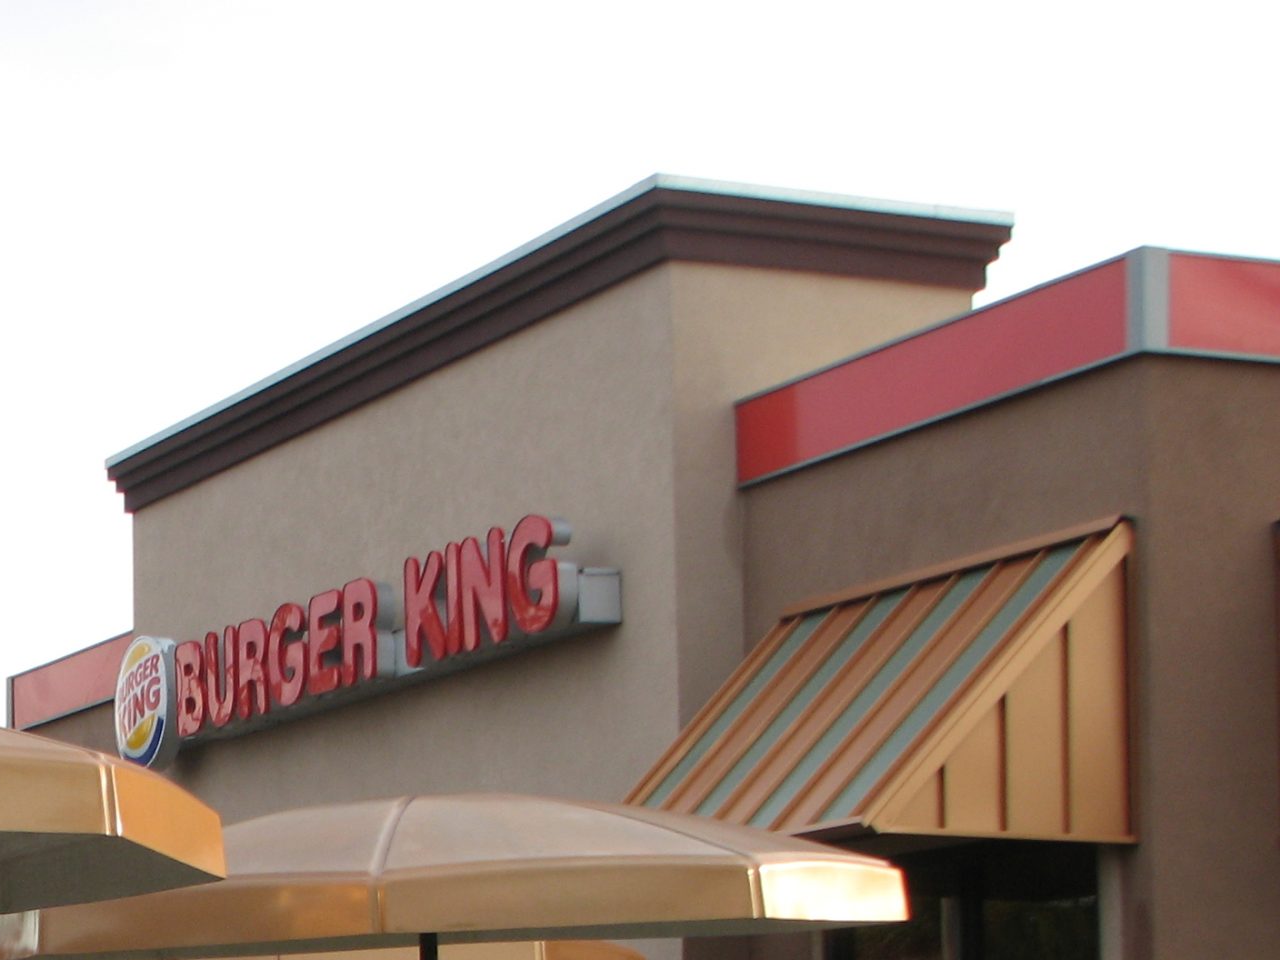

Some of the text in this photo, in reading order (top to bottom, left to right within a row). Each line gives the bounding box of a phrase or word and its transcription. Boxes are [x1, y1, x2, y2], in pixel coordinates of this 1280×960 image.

[175, 514, 557, 737] BURGER KING
[118, 676, 160, 738] KING
